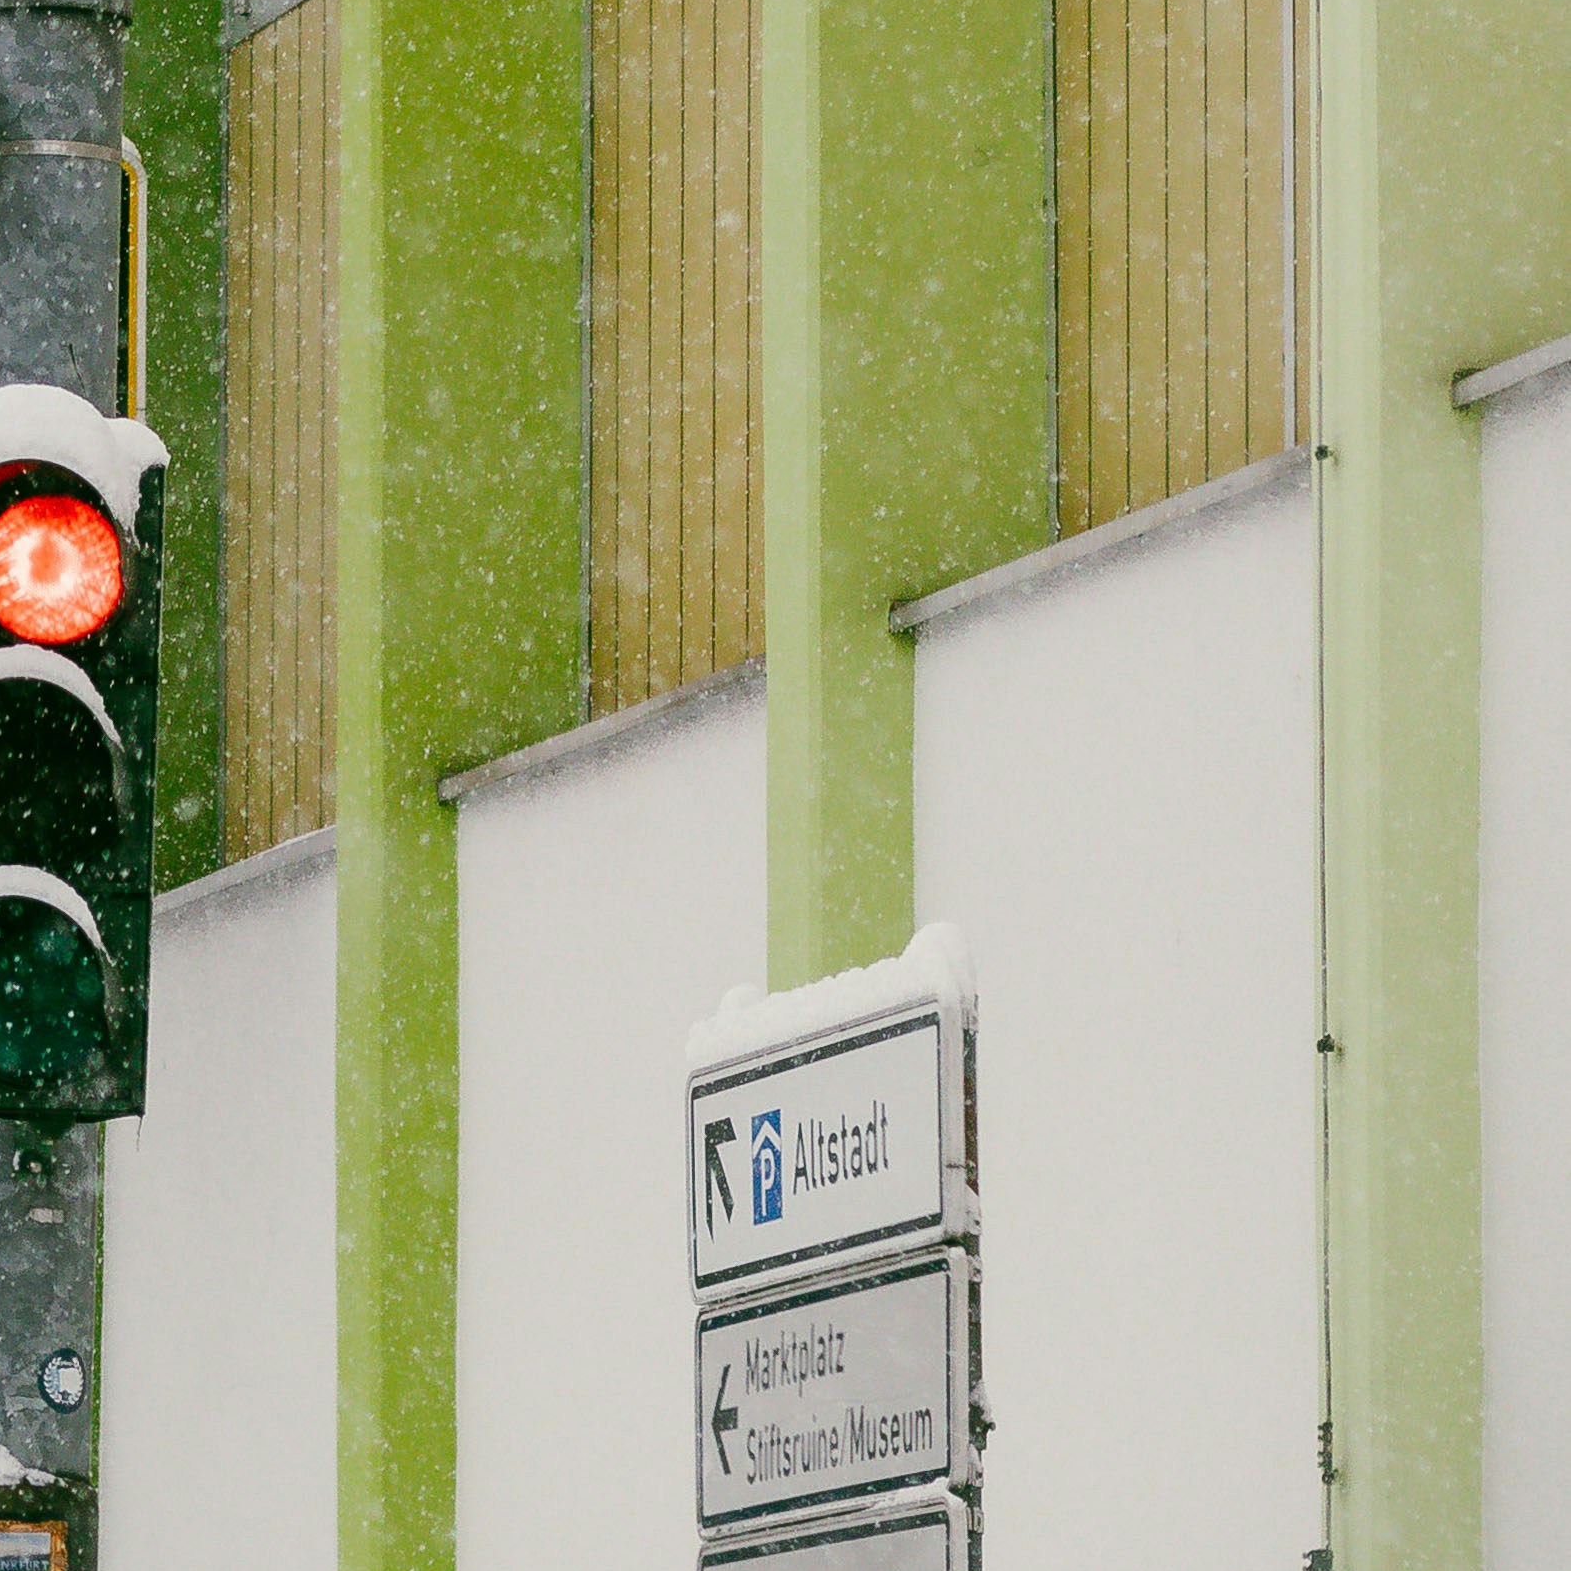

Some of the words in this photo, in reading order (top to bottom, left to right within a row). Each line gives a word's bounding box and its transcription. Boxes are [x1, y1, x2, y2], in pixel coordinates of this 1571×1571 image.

[792, 1099, 889, 1195] Altstadt
[745, 1322, 846, 1397] Marktplatz
[746, 1404, 933, 1485] Stiftsruine/Museum
